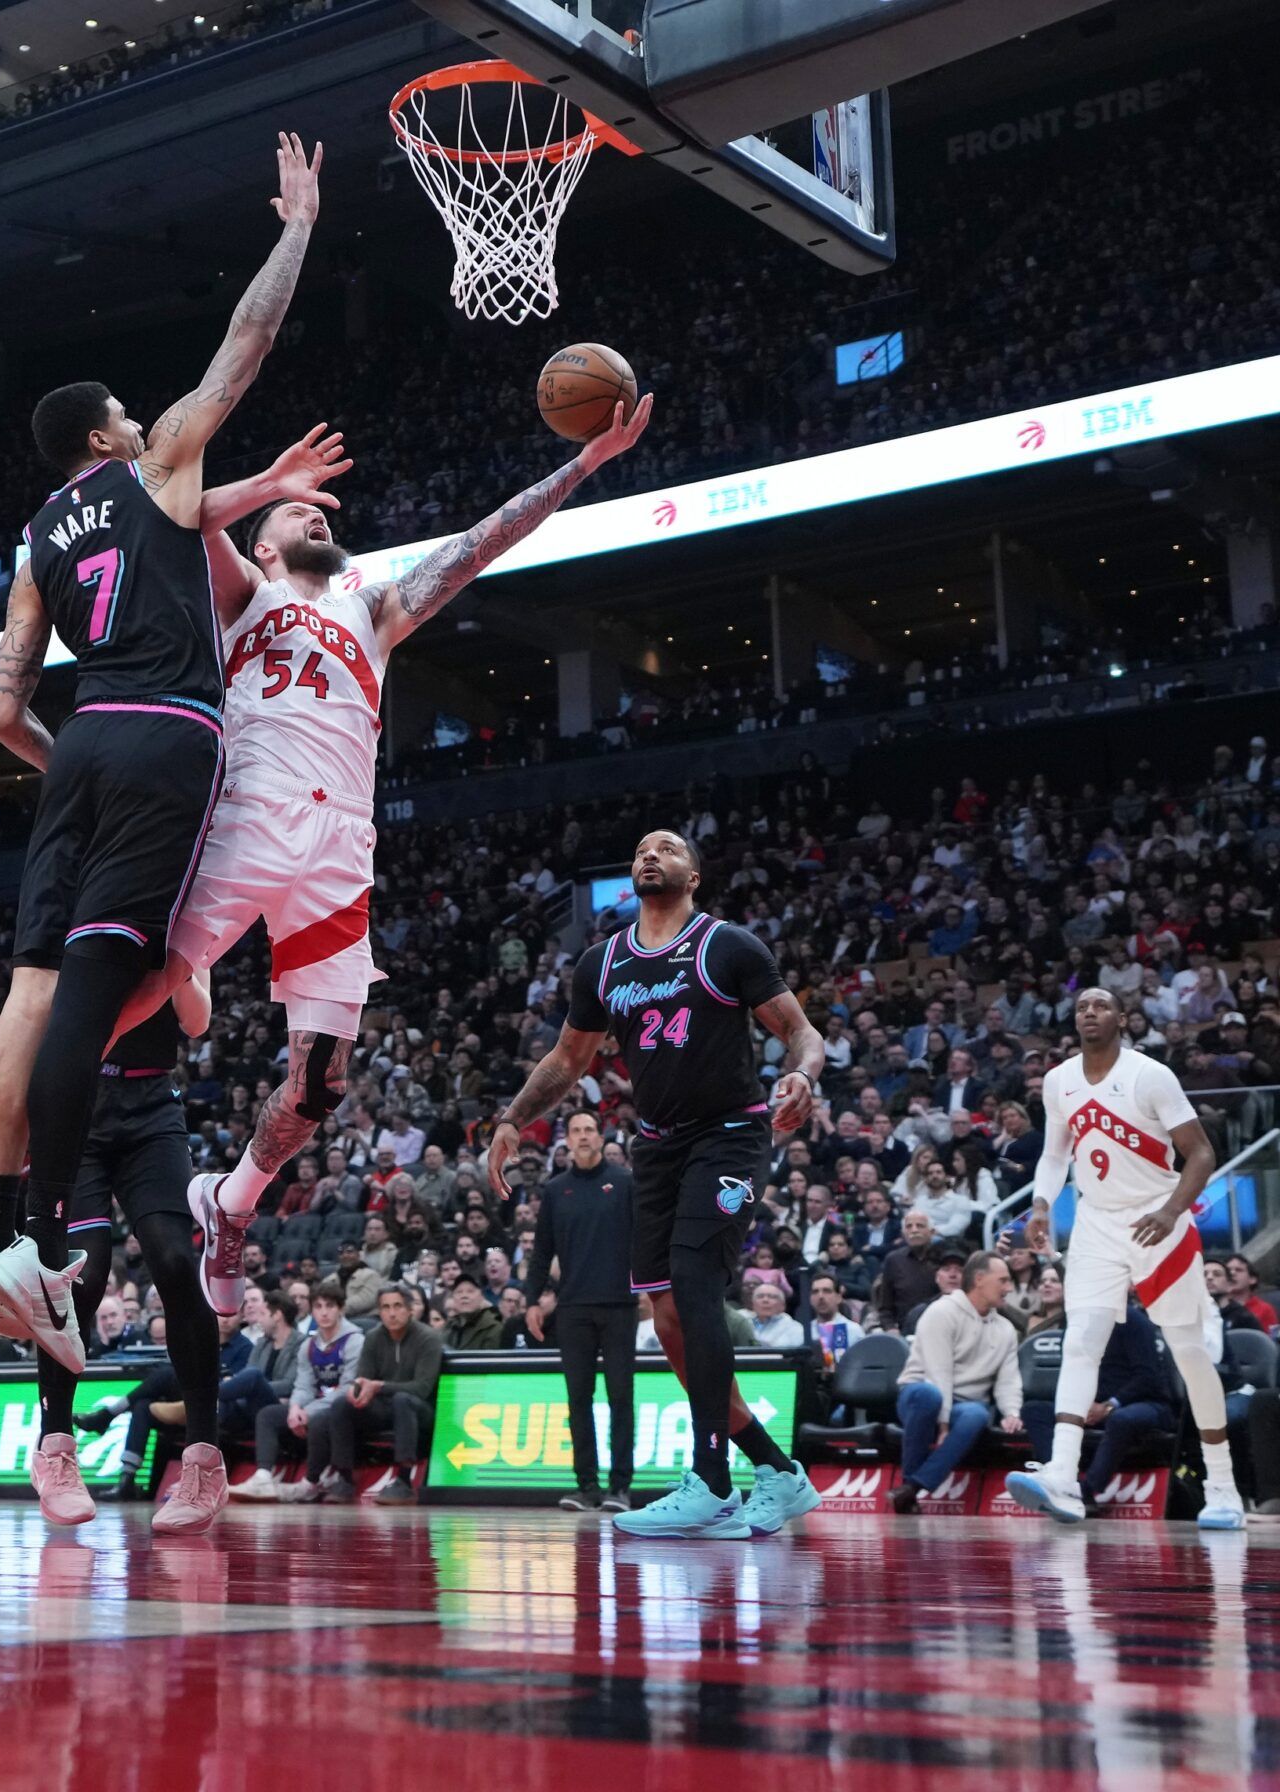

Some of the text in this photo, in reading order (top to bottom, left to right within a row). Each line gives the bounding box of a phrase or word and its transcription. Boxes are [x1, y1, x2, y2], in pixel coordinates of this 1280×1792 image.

[945, 69, 1203, 165] FRONT STRE
[1082, 395, 1154, 438] IBM
[707, 479, 768, 516] IBM
[48, 500, 113, 551] WARE
[389, 553, 426, 581] IB
[77, 547, 125, 646] 7
[243, 608, 357, 661] RAPTORS
[262, 649, 329, 700] 54
[384, 799, 414, 821] 118
[606, 970, 691, 1018] Miami
[639, 1008, 691, 1049] 24
[1071, 1108, 1140, 1148] APTORS
[1090, 1148, 1110, 1181] 9
[446, 1396, 778, 1471] SUBWA
